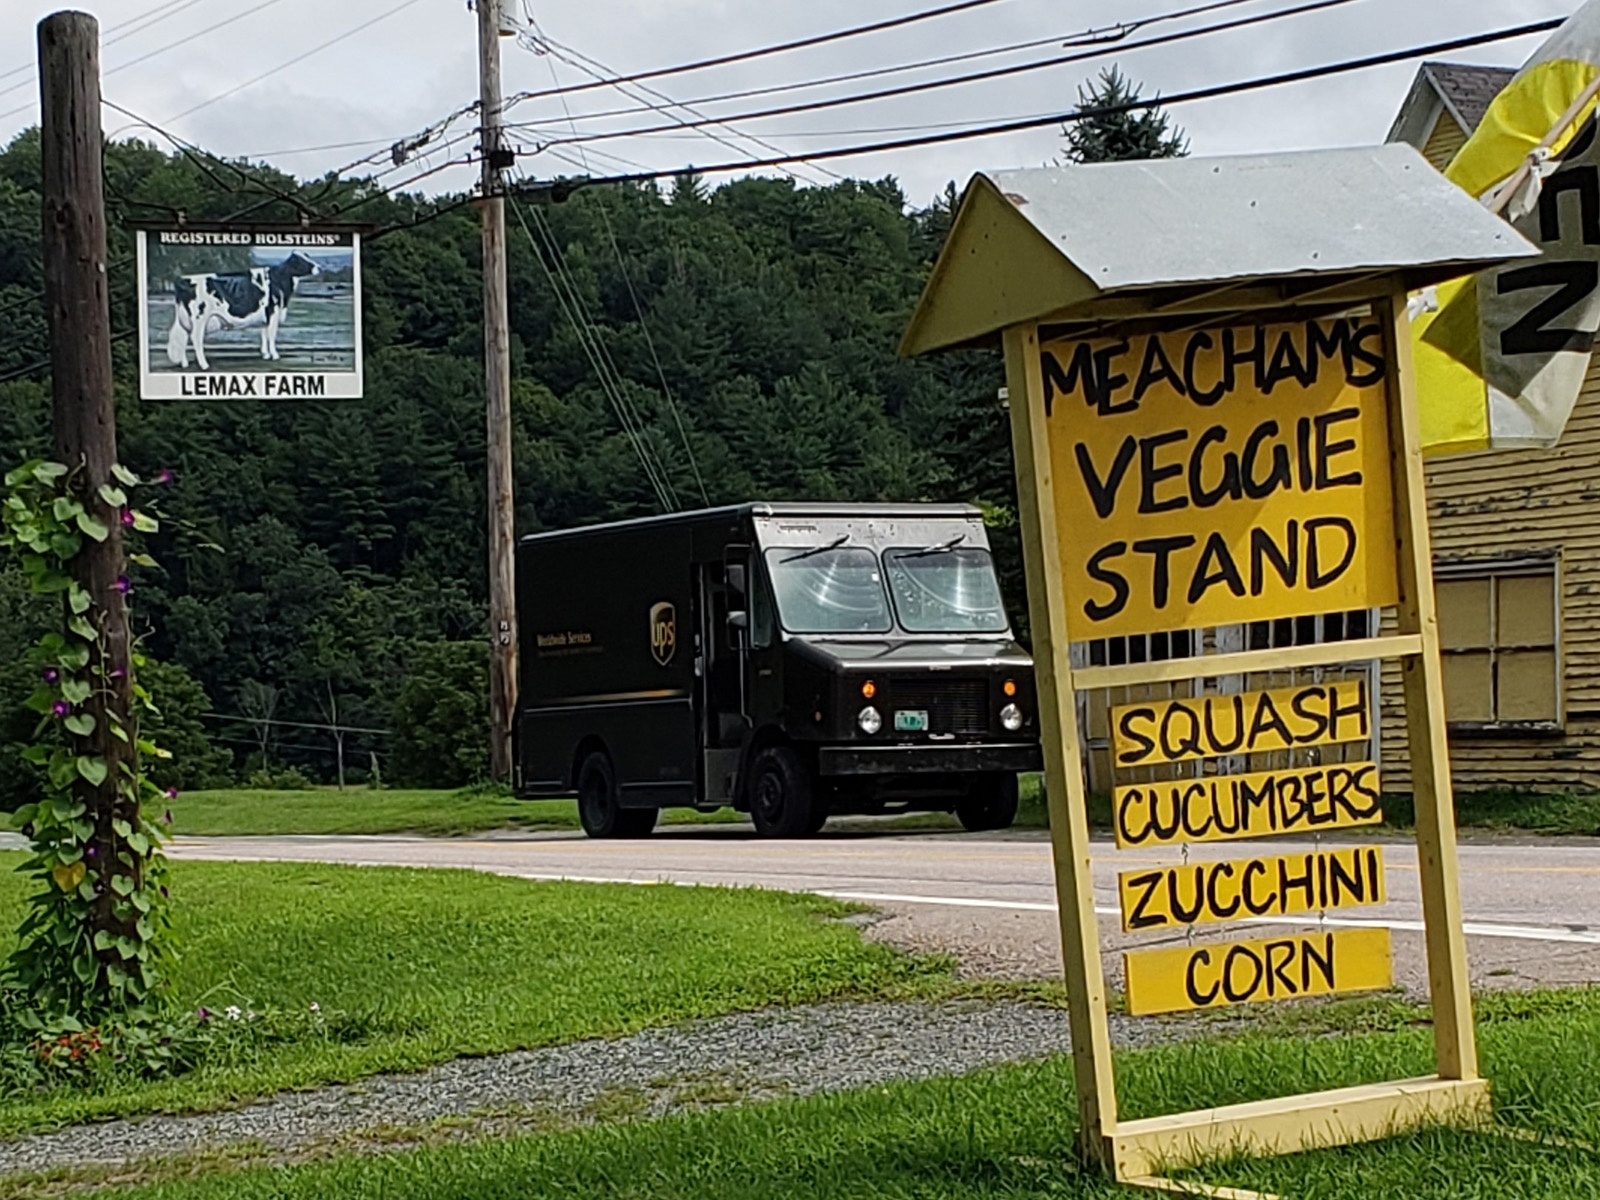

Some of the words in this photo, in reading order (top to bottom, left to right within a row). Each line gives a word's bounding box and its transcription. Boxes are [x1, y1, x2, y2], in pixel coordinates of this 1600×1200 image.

[160, 231, 251, 245] REGISTERED
[181, 375, 257, 396] LEMAX
[264, 375, 325, 396] FARM
[1074, 407, 1363, 520] VEGGIE
[1083, 516, 1357, 622] STAND
[1119, 680, 1367, 763] SQUASH
[1119, 765, 1381, 844] CUCUMBERS
[1127, 848, 1379, 928] ZUCCHINI
[1186, 932, 1335, 1006] CORN
